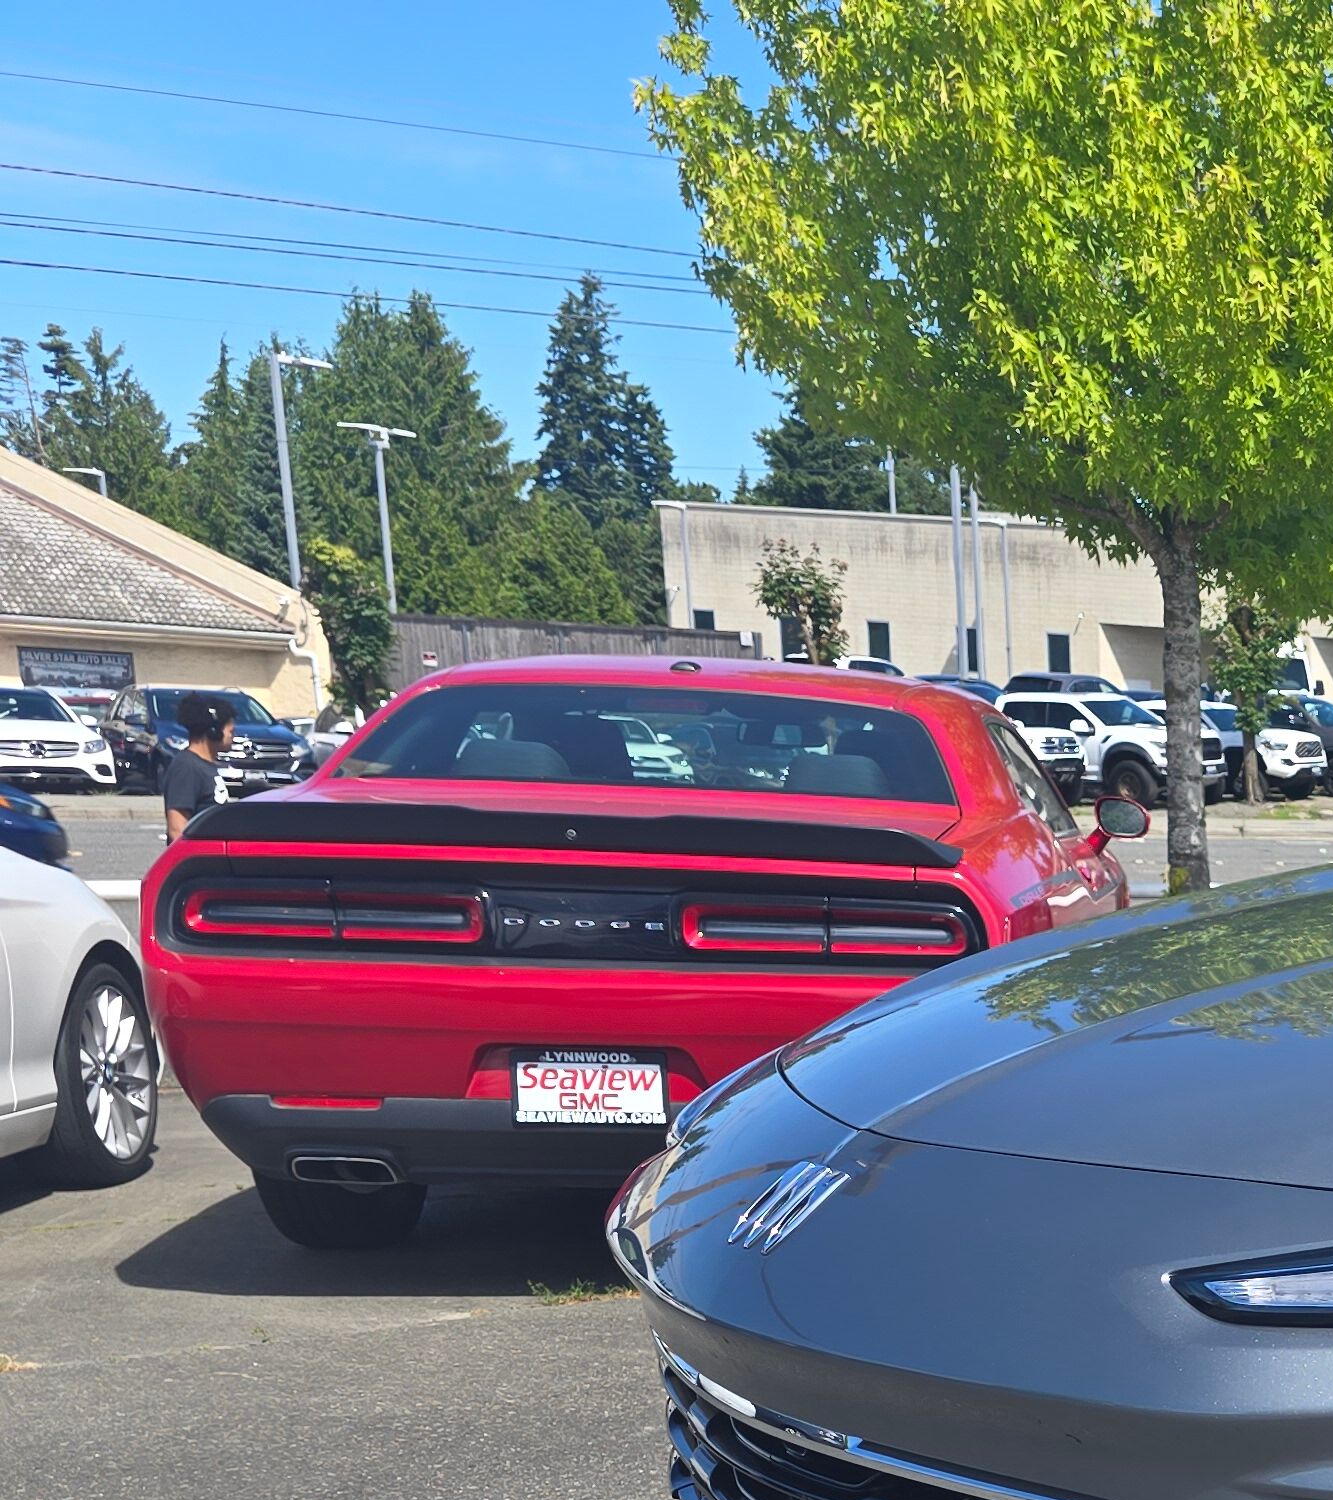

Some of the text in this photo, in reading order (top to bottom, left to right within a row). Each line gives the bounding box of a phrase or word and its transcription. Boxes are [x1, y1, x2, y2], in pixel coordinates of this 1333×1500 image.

[21, 650, 129, 667] SILVER STAR AUTO SALES
[503, 917, 665, 931] DODGE
[545, 1051, 631, 1064] LYNNWOOD
[519, 1063, 659, 1091] Seaview
[559, 1092, 623, 1111] GMC
[515, 1110, 667, 1125] SEAVIEWAUTO.COM
